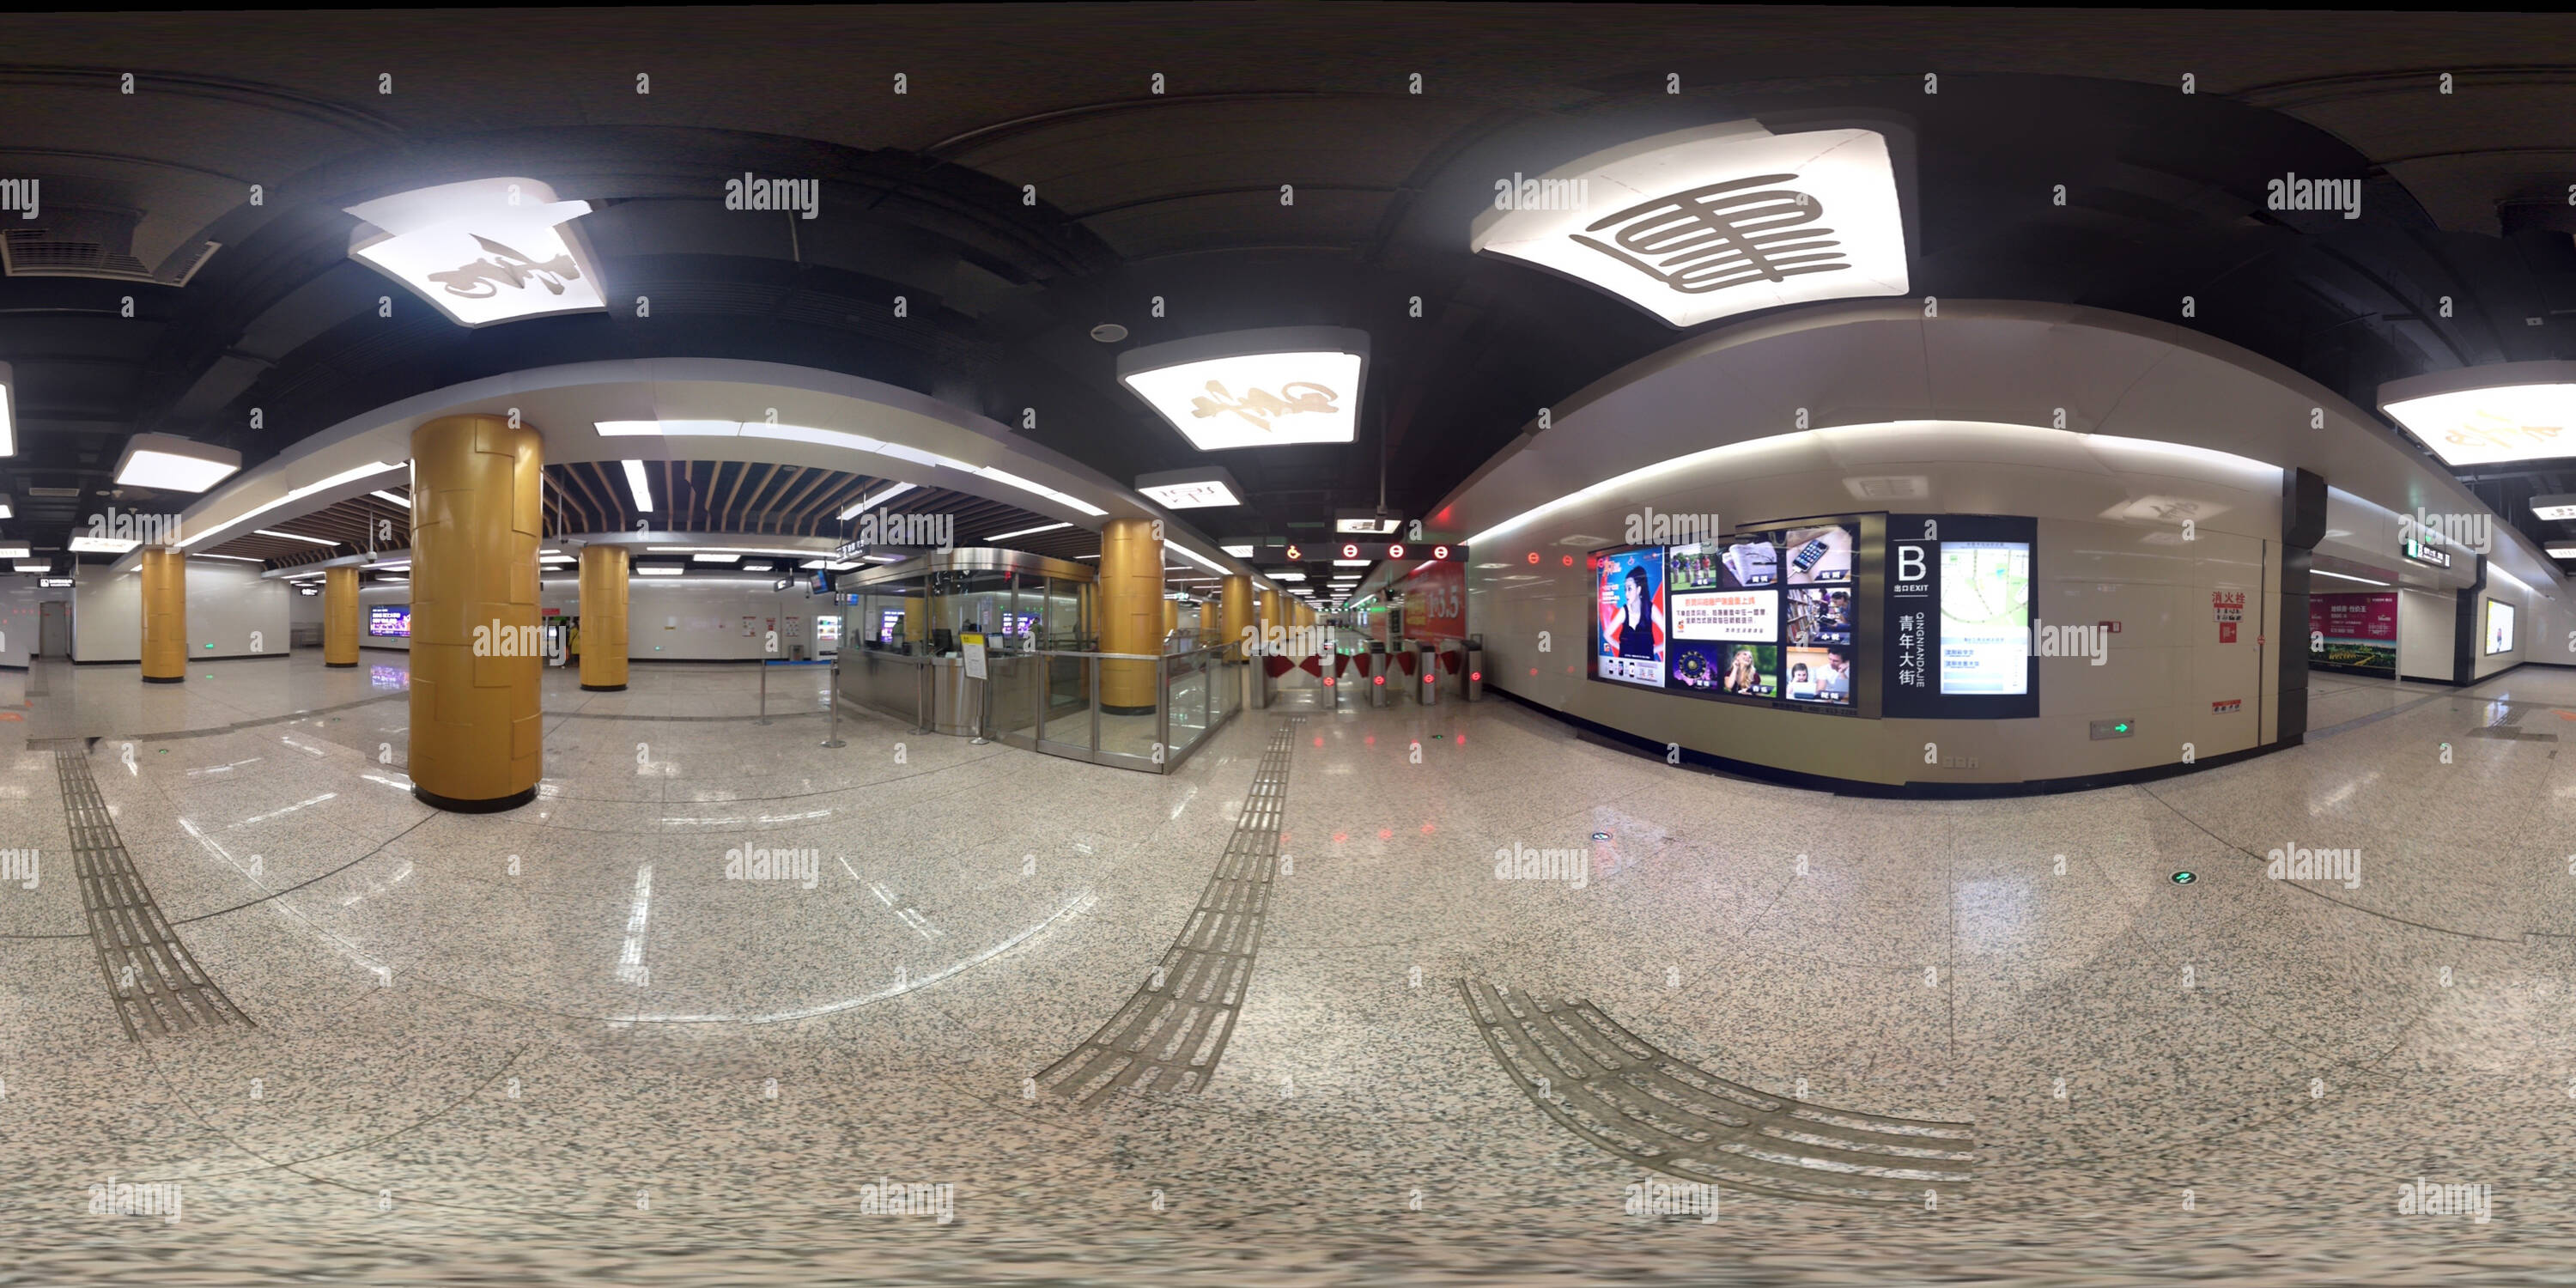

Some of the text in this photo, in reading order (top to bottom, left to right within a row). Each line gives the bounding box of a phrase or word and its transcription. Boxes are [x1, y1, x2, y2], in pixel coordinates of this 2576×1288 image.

[1898, 545, 1927, 581] B
[2211, 591, 2245, 604] 消火栓
[1899, 614, 1916, 686] 青年大街
[1916, 612, 1925, 688] QINGNIANDAJIE
